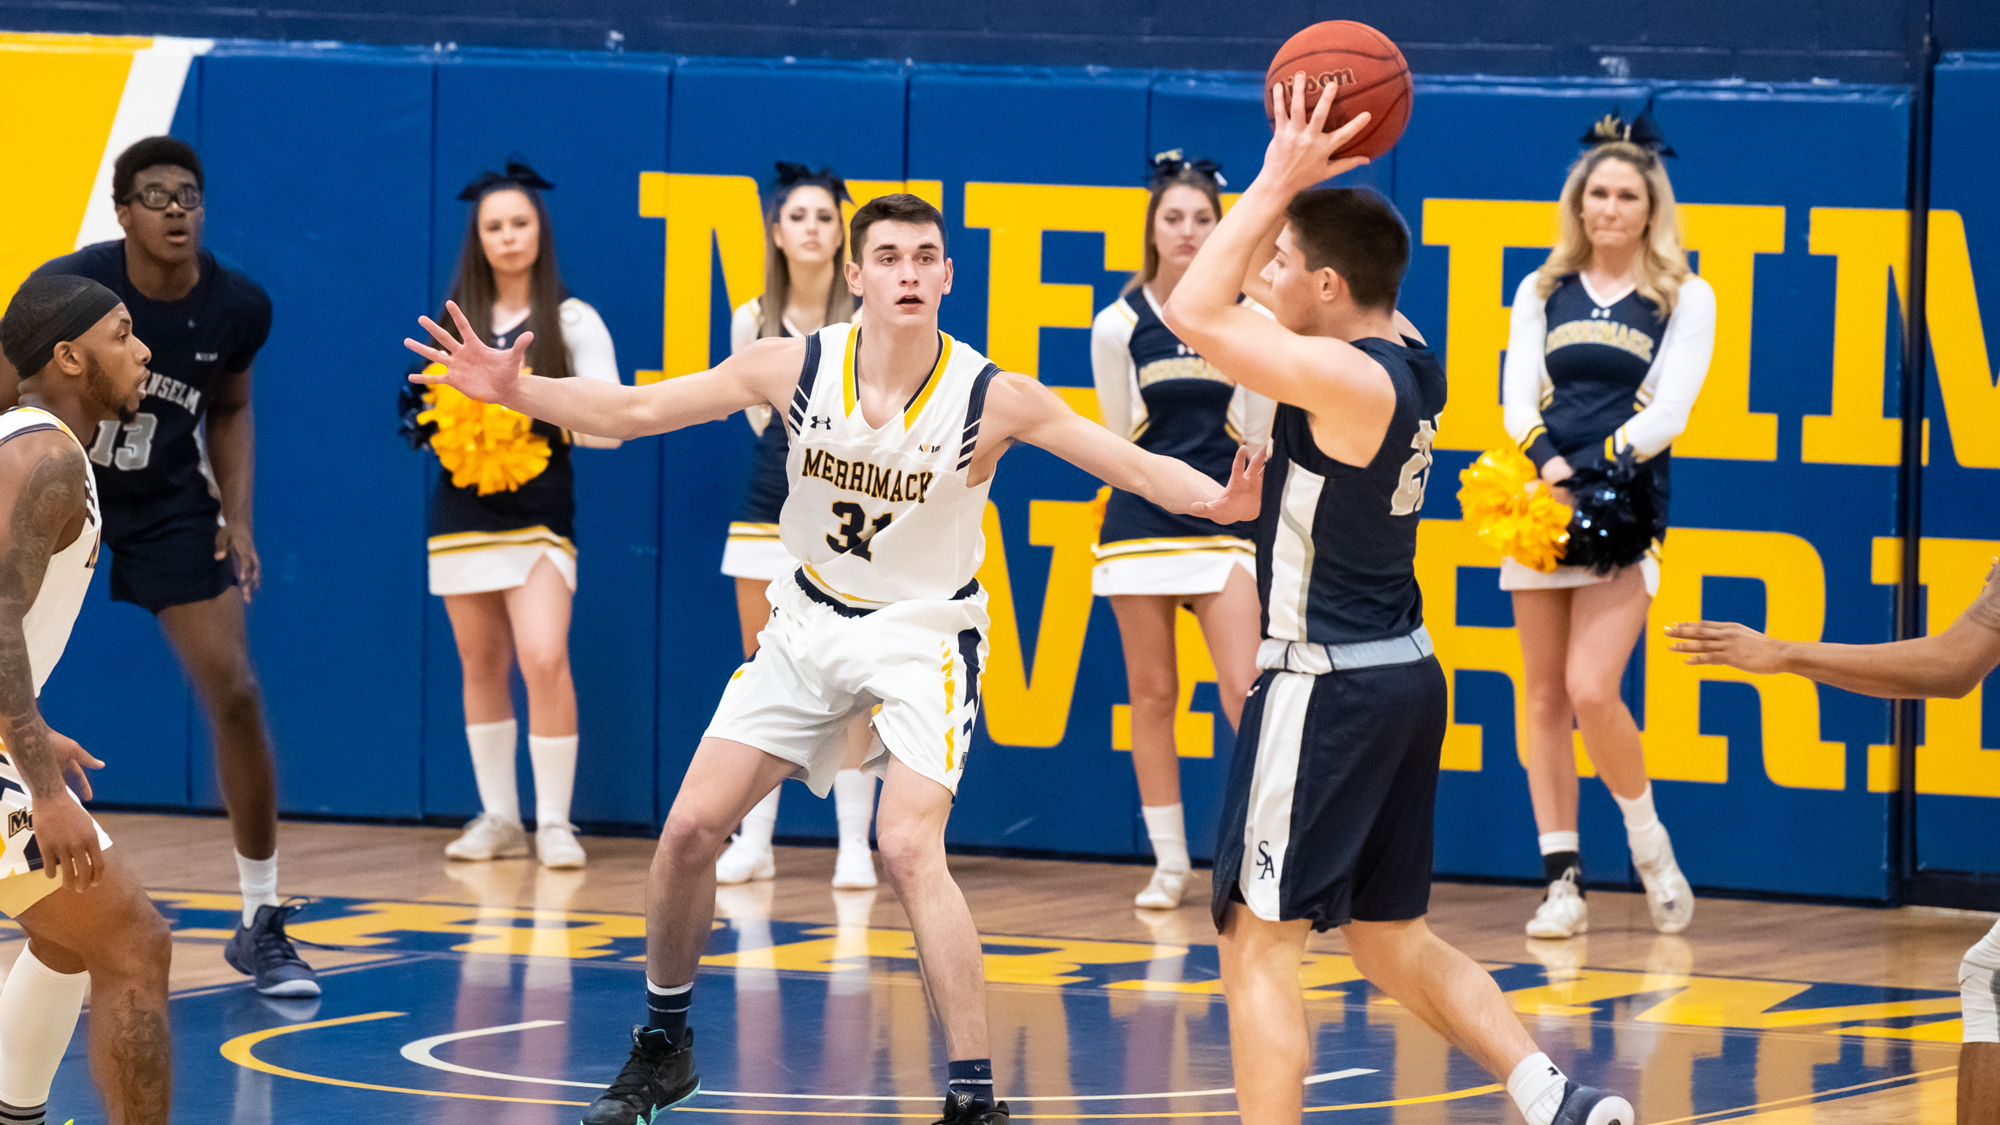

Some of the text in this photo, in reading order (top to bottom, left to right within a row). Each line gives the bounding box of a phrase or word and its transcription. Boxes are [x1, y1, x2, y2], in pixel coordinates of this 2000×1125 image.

[146, 372, 202, 416] NSELM
[88, 412, 158, 471] 13
[801, 447, 934, 504] MERRIMACK
[825, 500, 894, 563] 31
[1256, 840, 1275, 880] SA
